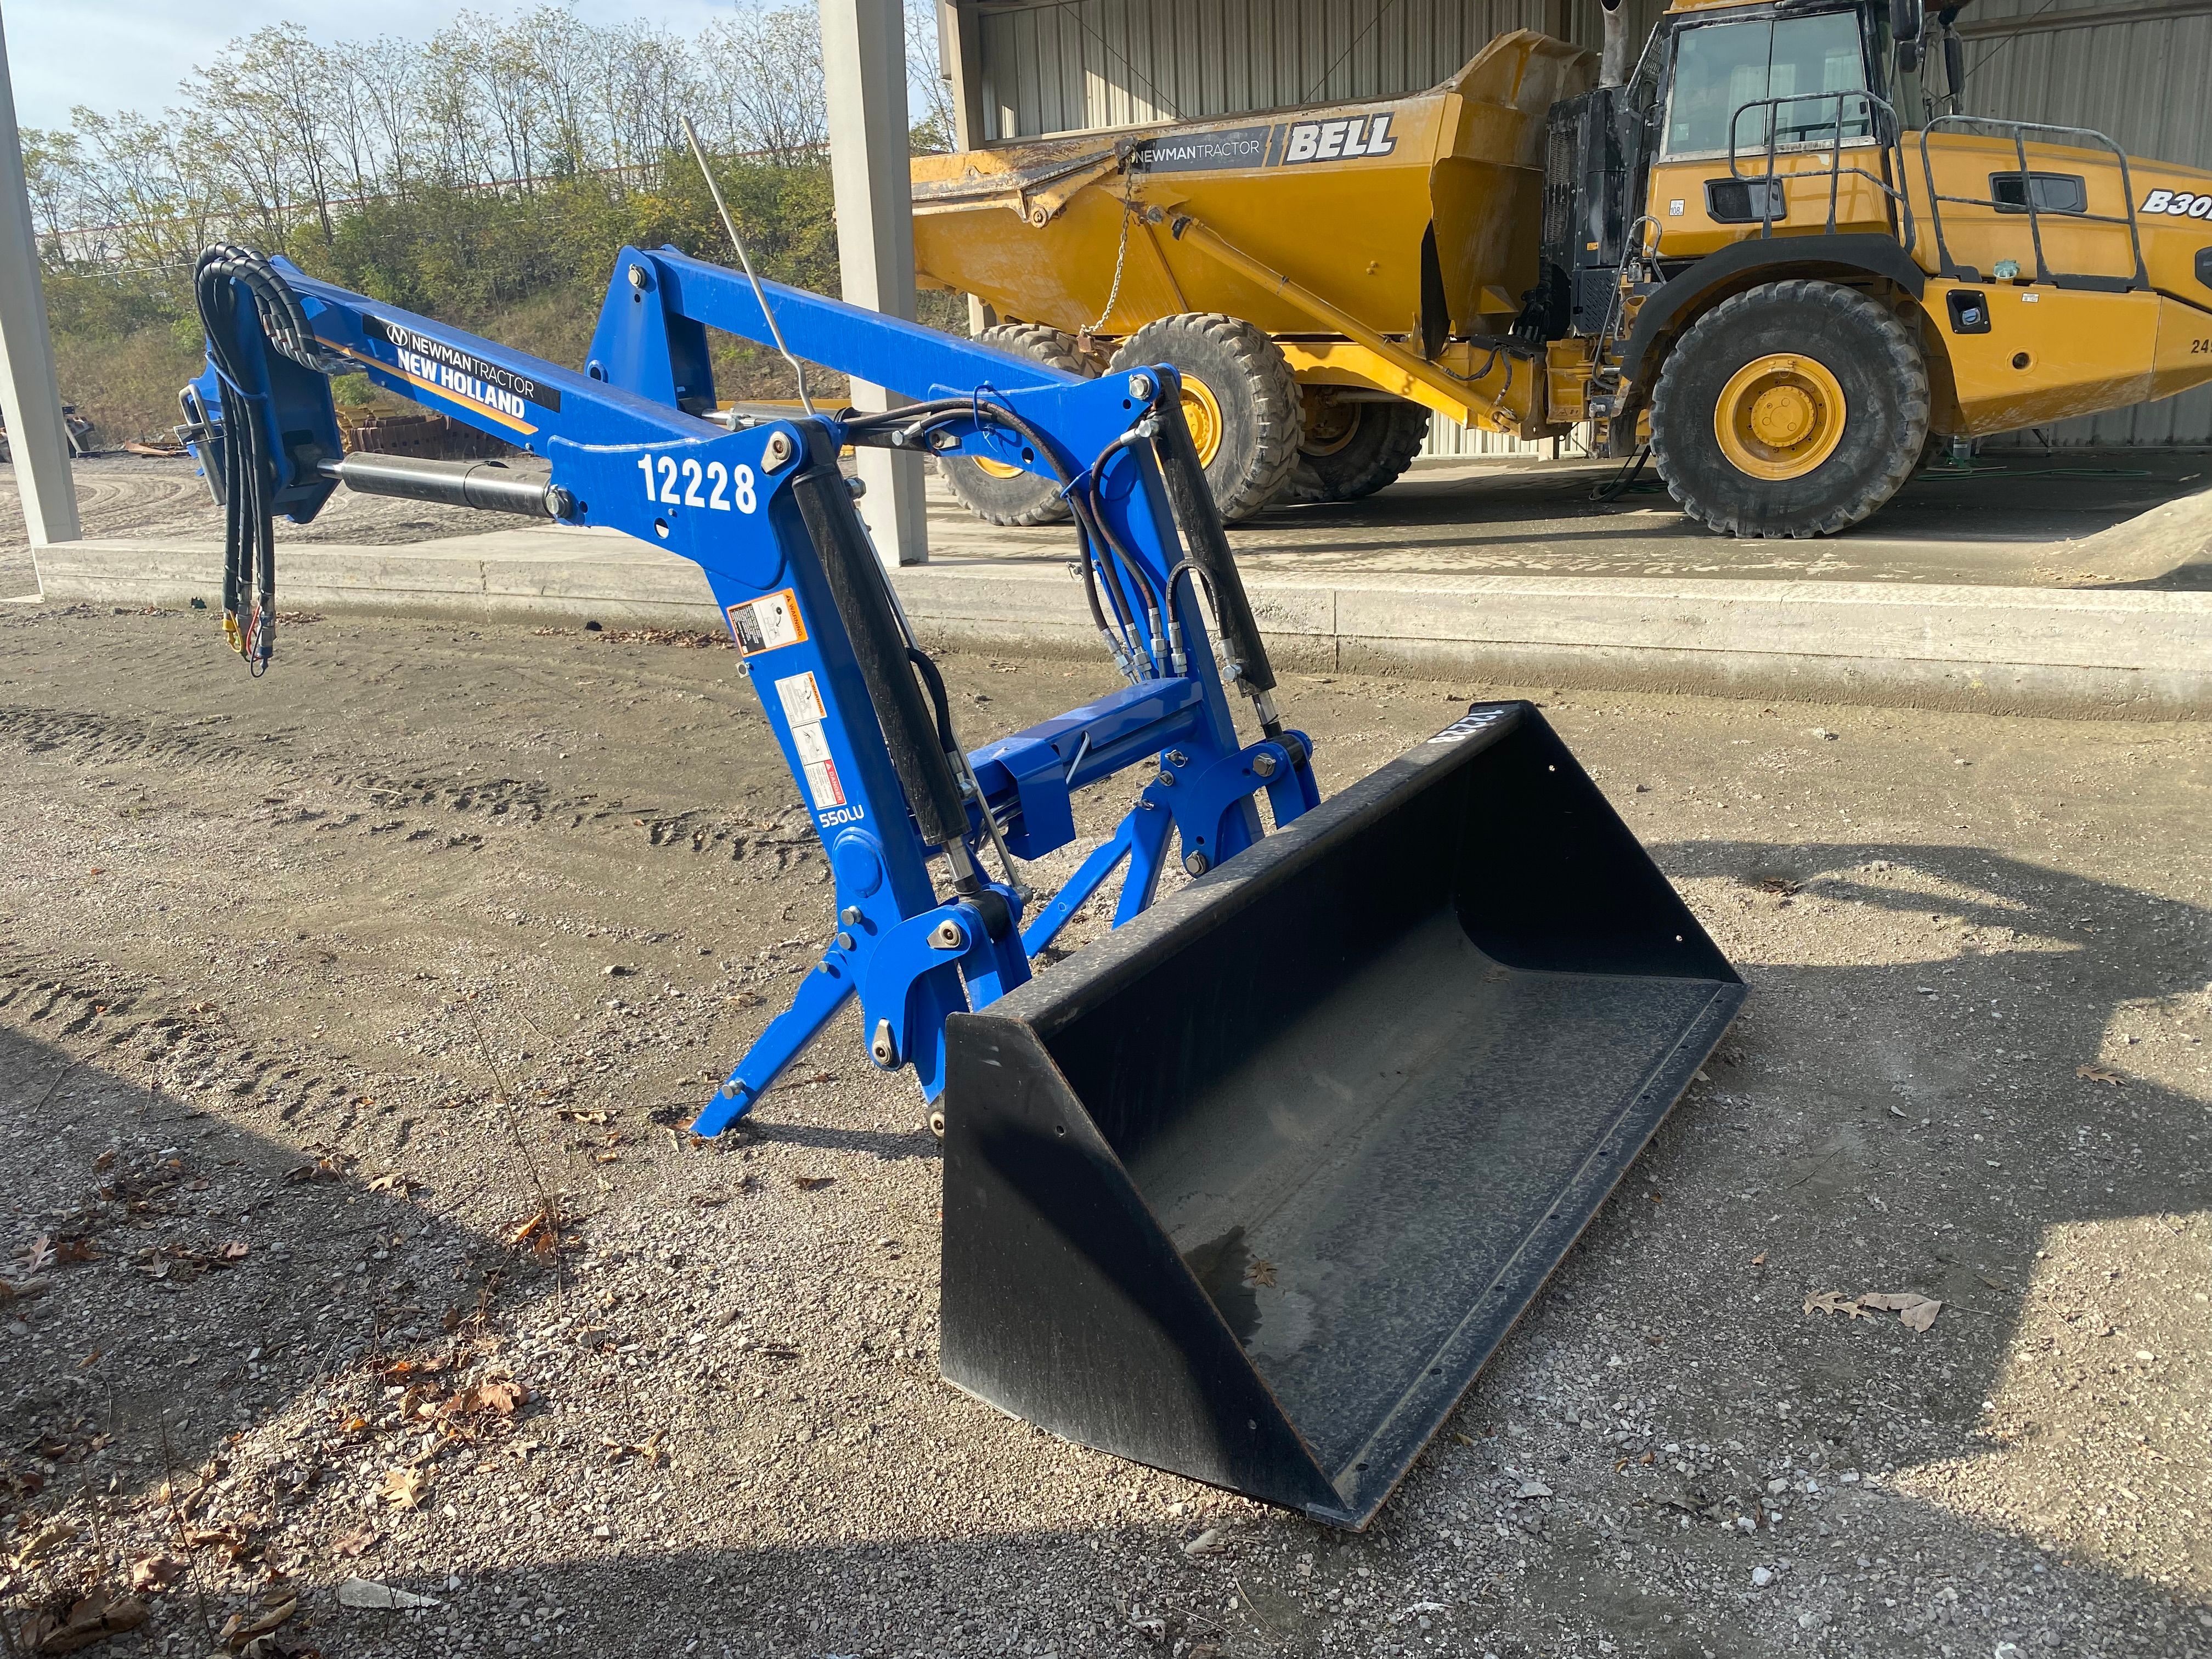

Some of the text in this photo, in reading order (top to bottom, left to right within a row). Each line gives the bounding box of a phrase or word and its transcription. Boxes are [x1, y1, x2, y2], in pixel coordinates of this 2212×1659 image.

[1286, 117, 1392, 161] BELL
[1671, 206, 1680, 215] 108
[2142, 190, 2212, 219] B30
[2191, 339, 2212, 354] 24
[412, 334, 534, 398] NEWMANTRACTOR
[398, 348, 525, 419] NEW HOLLAND
[637, 454, 757, 514] 12228
[789, 603, 803, 636] WARNING
[811, 685, 823, 713] WARNING
[1427, 709, 1505, 743] 12228
[829, 771, 843, 801] DANGER
[819, 804, 865, 828] 550LU
